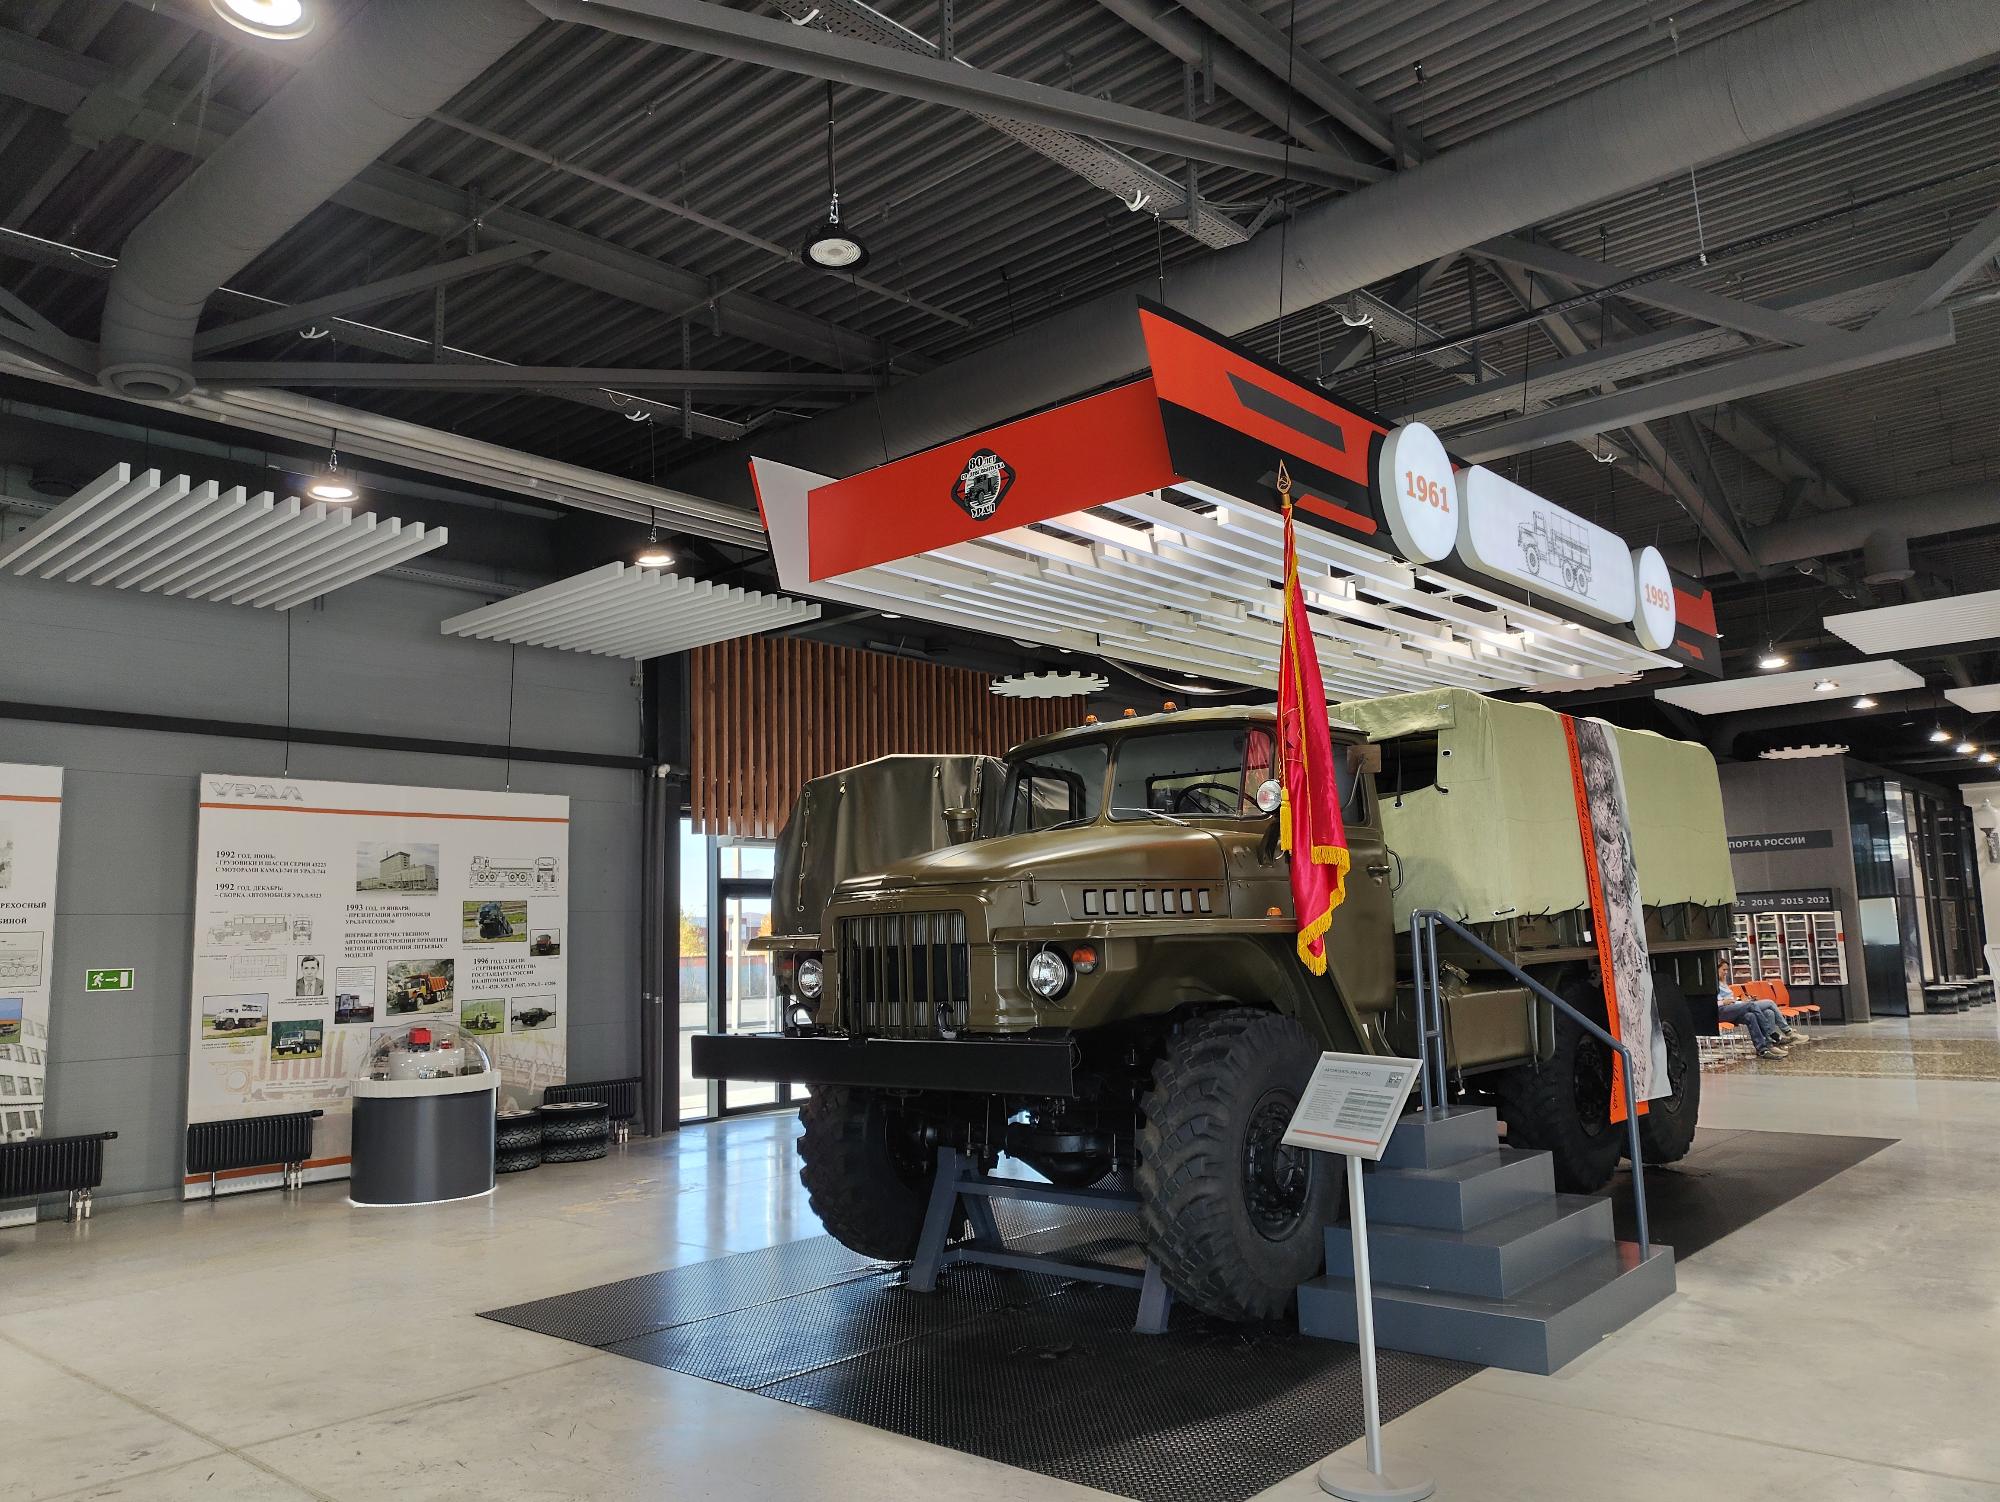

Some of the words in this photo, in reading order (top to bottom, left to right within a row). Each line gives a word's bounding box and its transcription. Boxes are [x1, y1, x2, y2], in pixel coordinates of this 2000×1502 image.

[969, 456, 983, 470] 80
[1405, 470, 1450, 513] 1961
[1645, 583, 1670, 611] 1993
[208, 782, 304, 801] УРАЛ
[1764, 836, 1806, 846] РОССИИ
[216, 850, 235, 859] 1992
[215, 883, 235, 891] 1992
[1807, 896, 1831, 904] 2021
